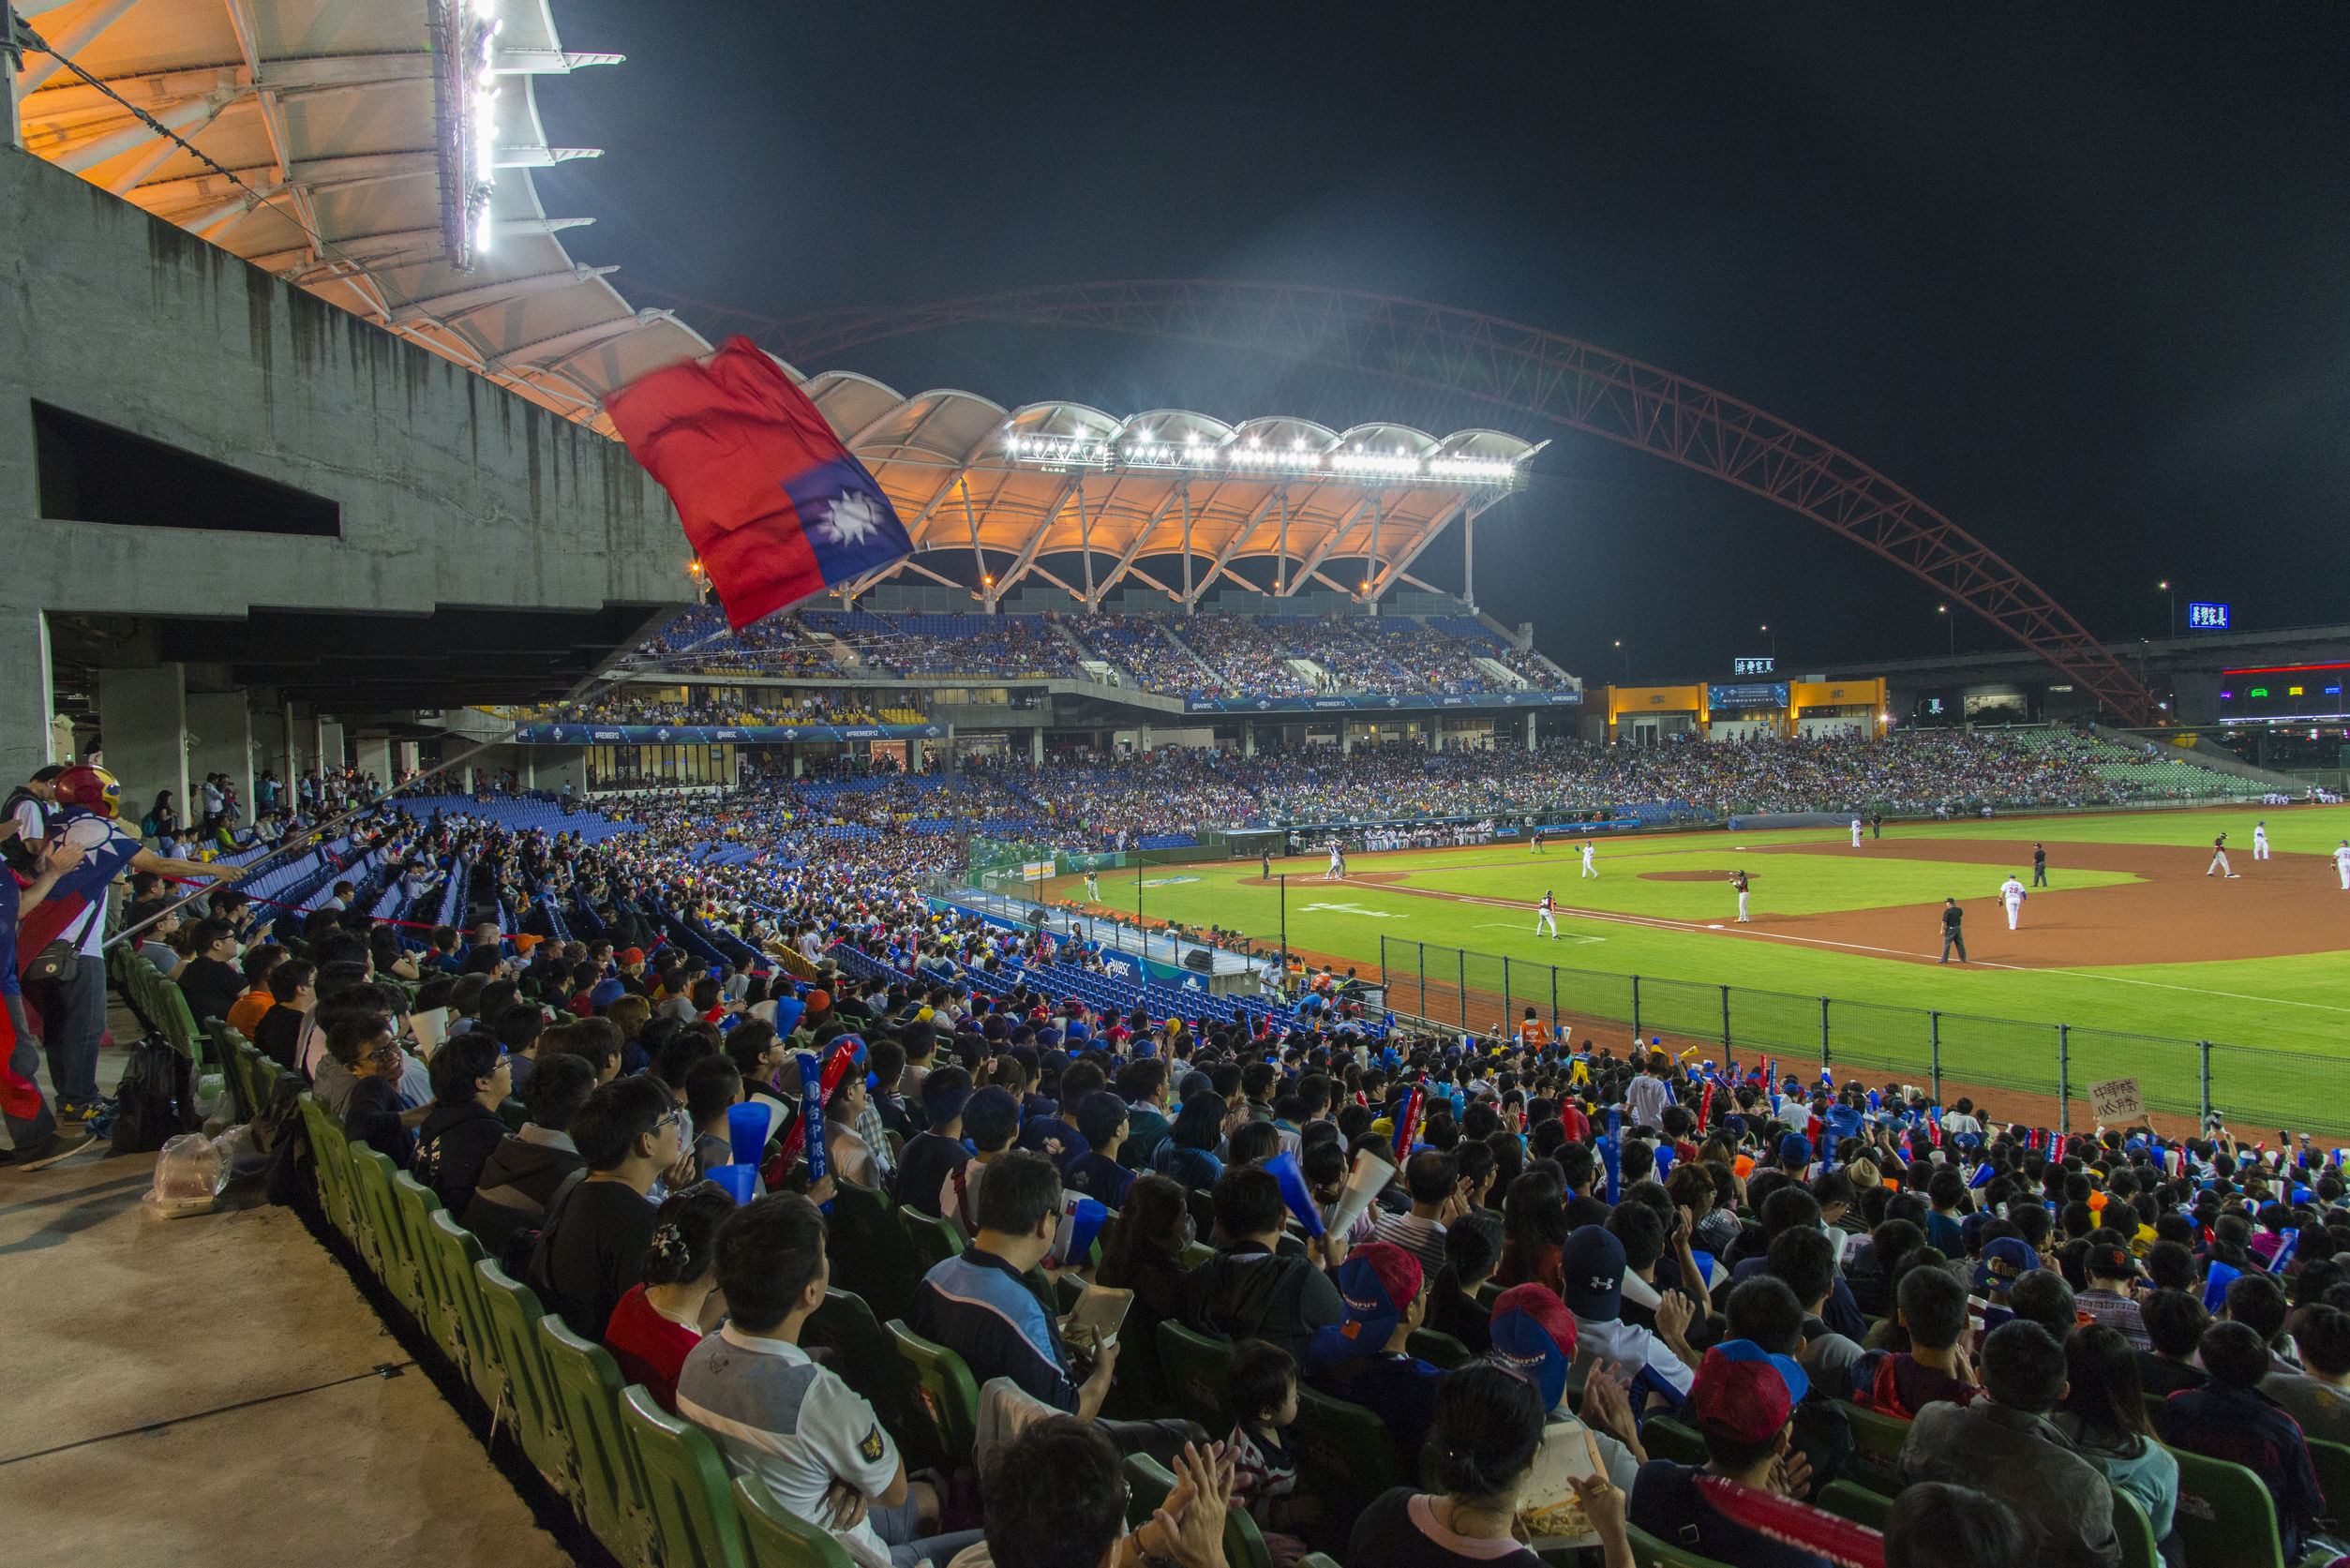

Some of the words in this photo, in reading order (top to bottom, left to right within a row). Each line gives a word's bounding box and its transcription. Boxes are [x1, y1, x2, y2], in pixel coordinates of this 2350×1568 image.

[594, 731, 620, 739] #PREMIER12
[717, 731, 737, 739] @WBSC
[2098, 1095, 2139, 1117] 必勝
[808, 1106, 826, 1176] 台中銀行
